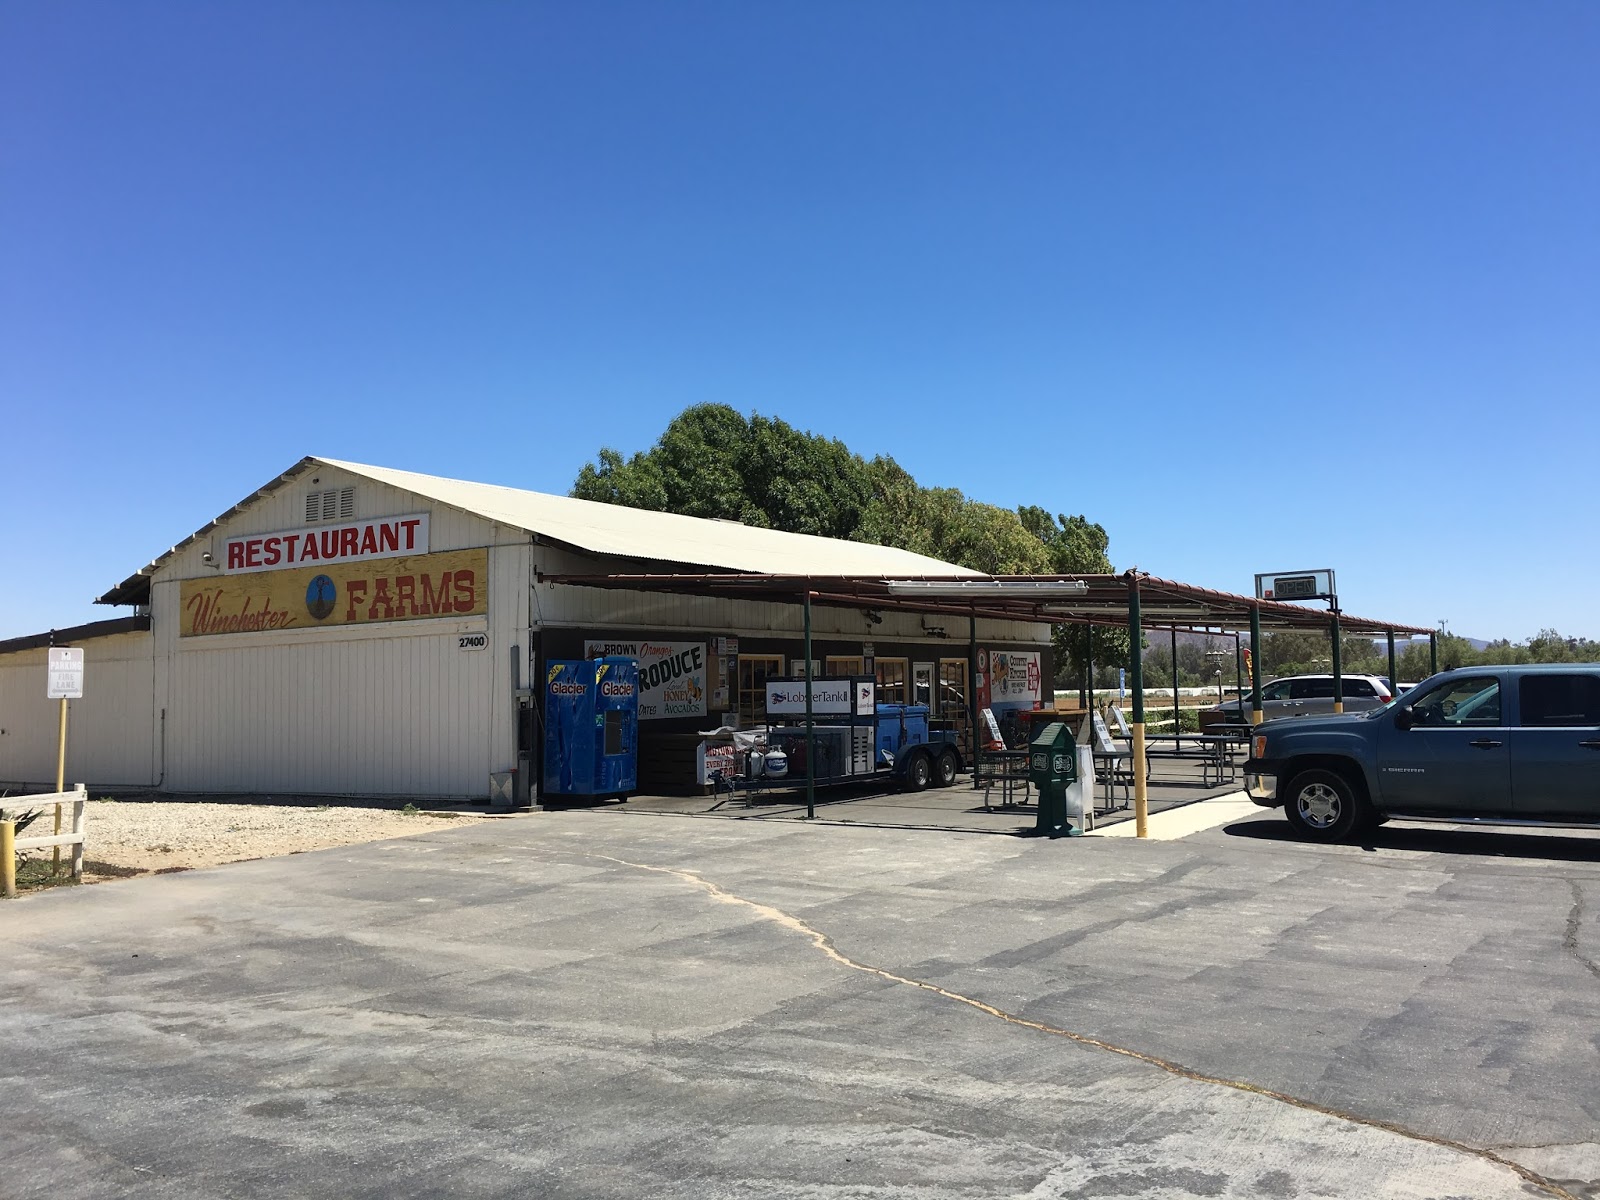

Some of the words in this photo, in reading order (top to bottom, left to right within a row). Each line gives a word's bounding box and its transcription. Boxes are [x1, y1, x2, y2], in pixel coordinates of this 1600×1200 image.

[228, 519, 420, 569] RESTAURANT
[1276, 581, 1313, 594] OPEN
[186, 589, 297, 634] Winchester
[346, 569, 475, 621] FARMS
[459, 636, 484, 648] 27400
[605, 644, 636, 655] BROWN
[61, 651, 71, 661] NO
[50, 661, 81, 670] PARKING
[639, 646, 702, 693] RODUCE
[58, 673, 75, 681] FIRE
[56, 681, 76, 689] LANE
[551, 683, 587, 694] Glacier
[602, 682, 634, 695] Glacier
[664, 690, 689, 701] HONEY
